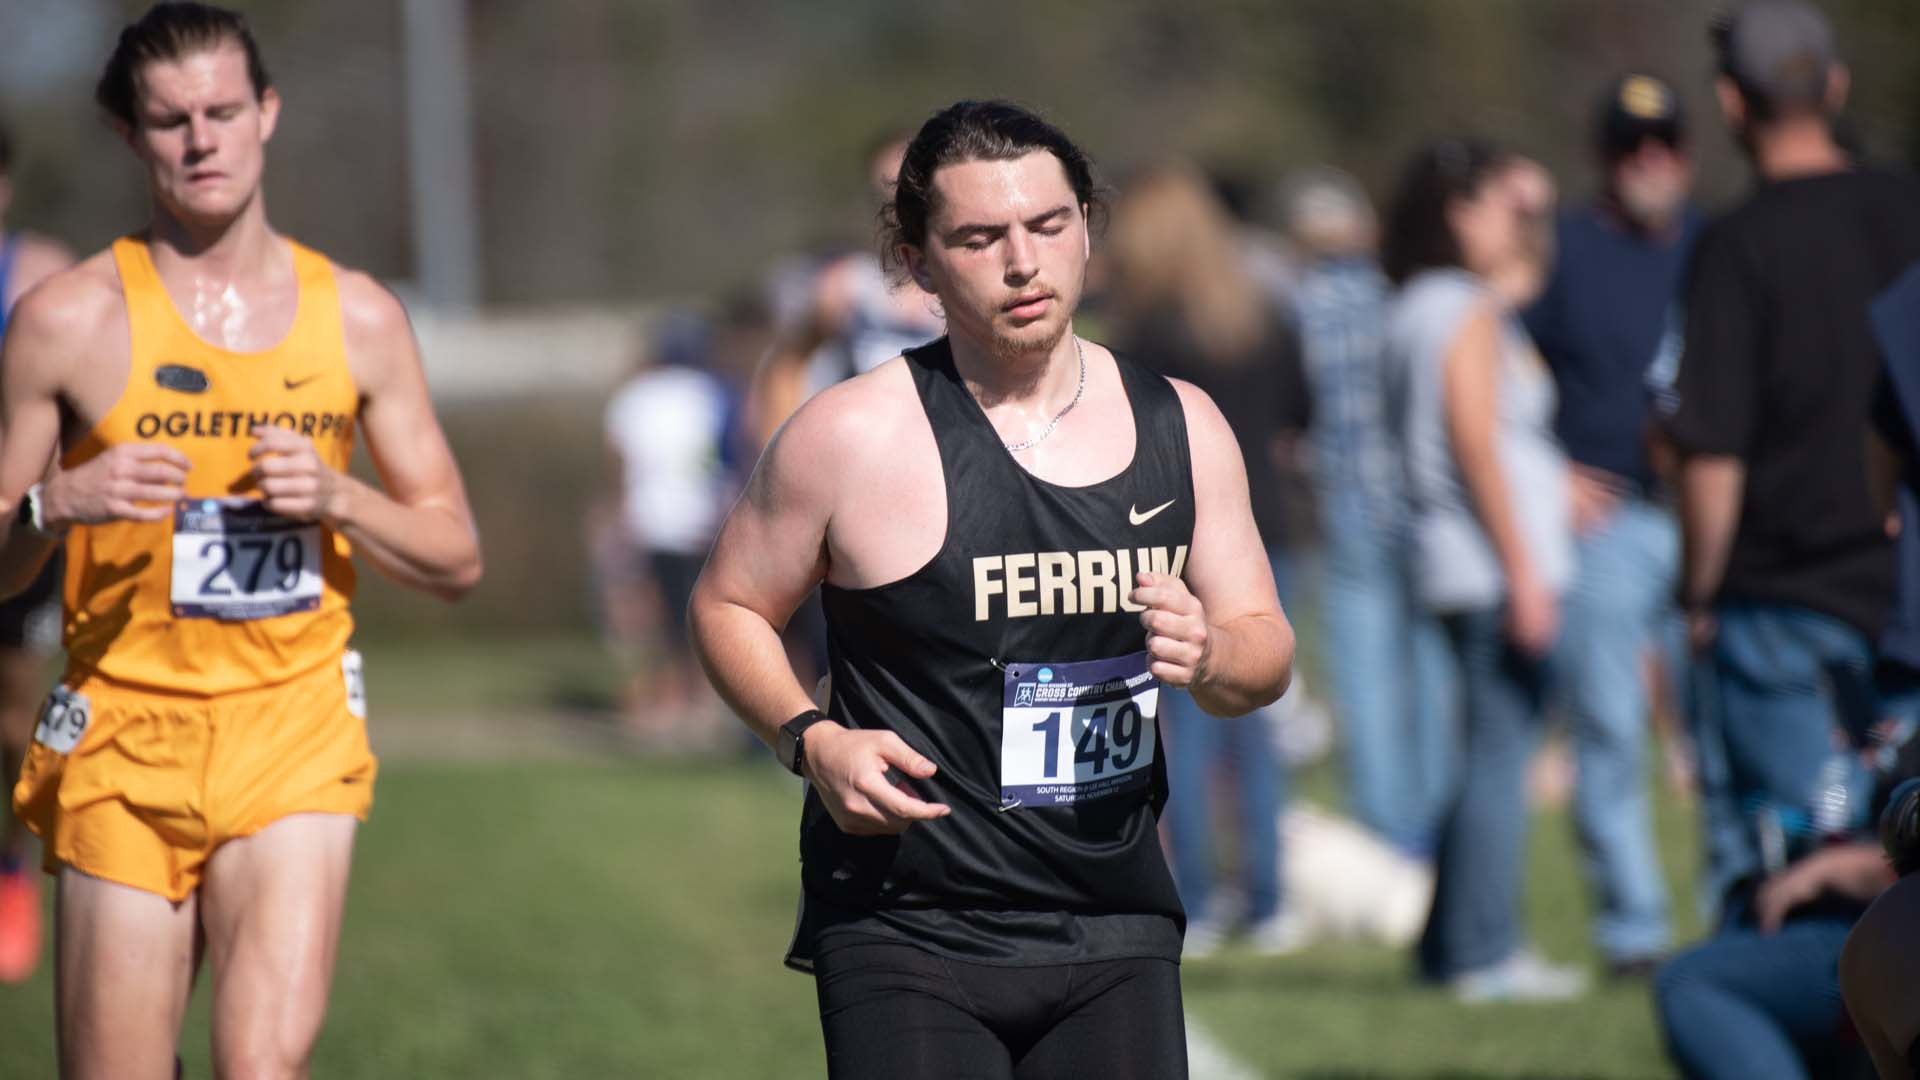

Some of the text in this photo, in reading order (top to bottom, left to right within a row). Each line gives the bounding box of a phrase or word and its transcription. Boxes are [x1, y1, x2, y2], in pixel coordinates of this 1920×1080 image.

[198, 536, 303, 595] 279
[1035, 687, 1066, 698] CROSS
[1068, 684, 1104, 697] COUNTRY
[1032, 701, 1141, 778] 149
[1036, 786, 1059, 794] SOUTH
